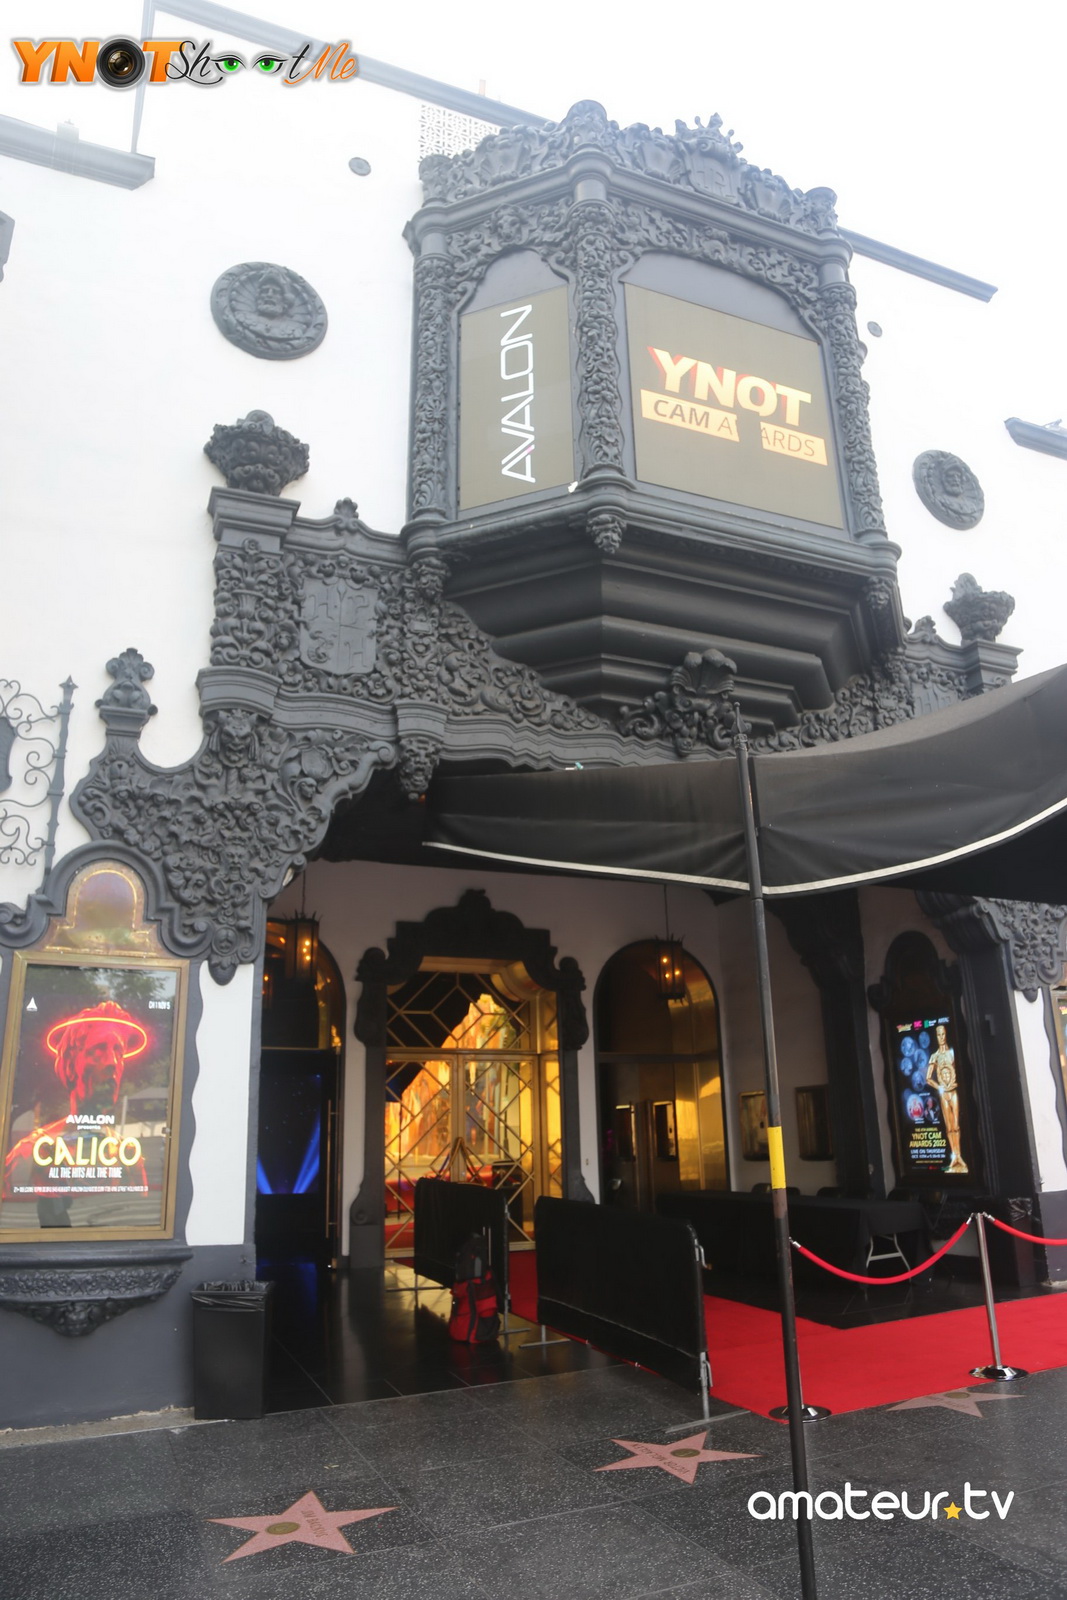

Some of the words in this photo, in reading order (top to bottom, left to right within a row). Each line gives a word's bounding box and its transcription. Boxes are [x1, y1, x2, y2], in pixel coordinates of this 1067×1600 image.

[500, 304, 536, 483] AVALON
[647, 346, 812, 427] YNOT
[653, 399, 711, 430] CAM
[717, 416, 816, 458] AARDS
[66, 1114, 115, 1125] AVALON
[33, 1136, 142, 1167] CALICO
[909, 1140, 932, 1148] AWARDS
[932, 1139, 947, 1147] 2022
[48, 1167, 59, 1179] ALL
[60, 1167, 71, 1179] THE
[72, 1167, 85, 1179] HITS
[85, 1167, 96, 1179] ALL
[97, 1167, 107, 1179] THE
[108, 1167, 122, 1179] TIME
